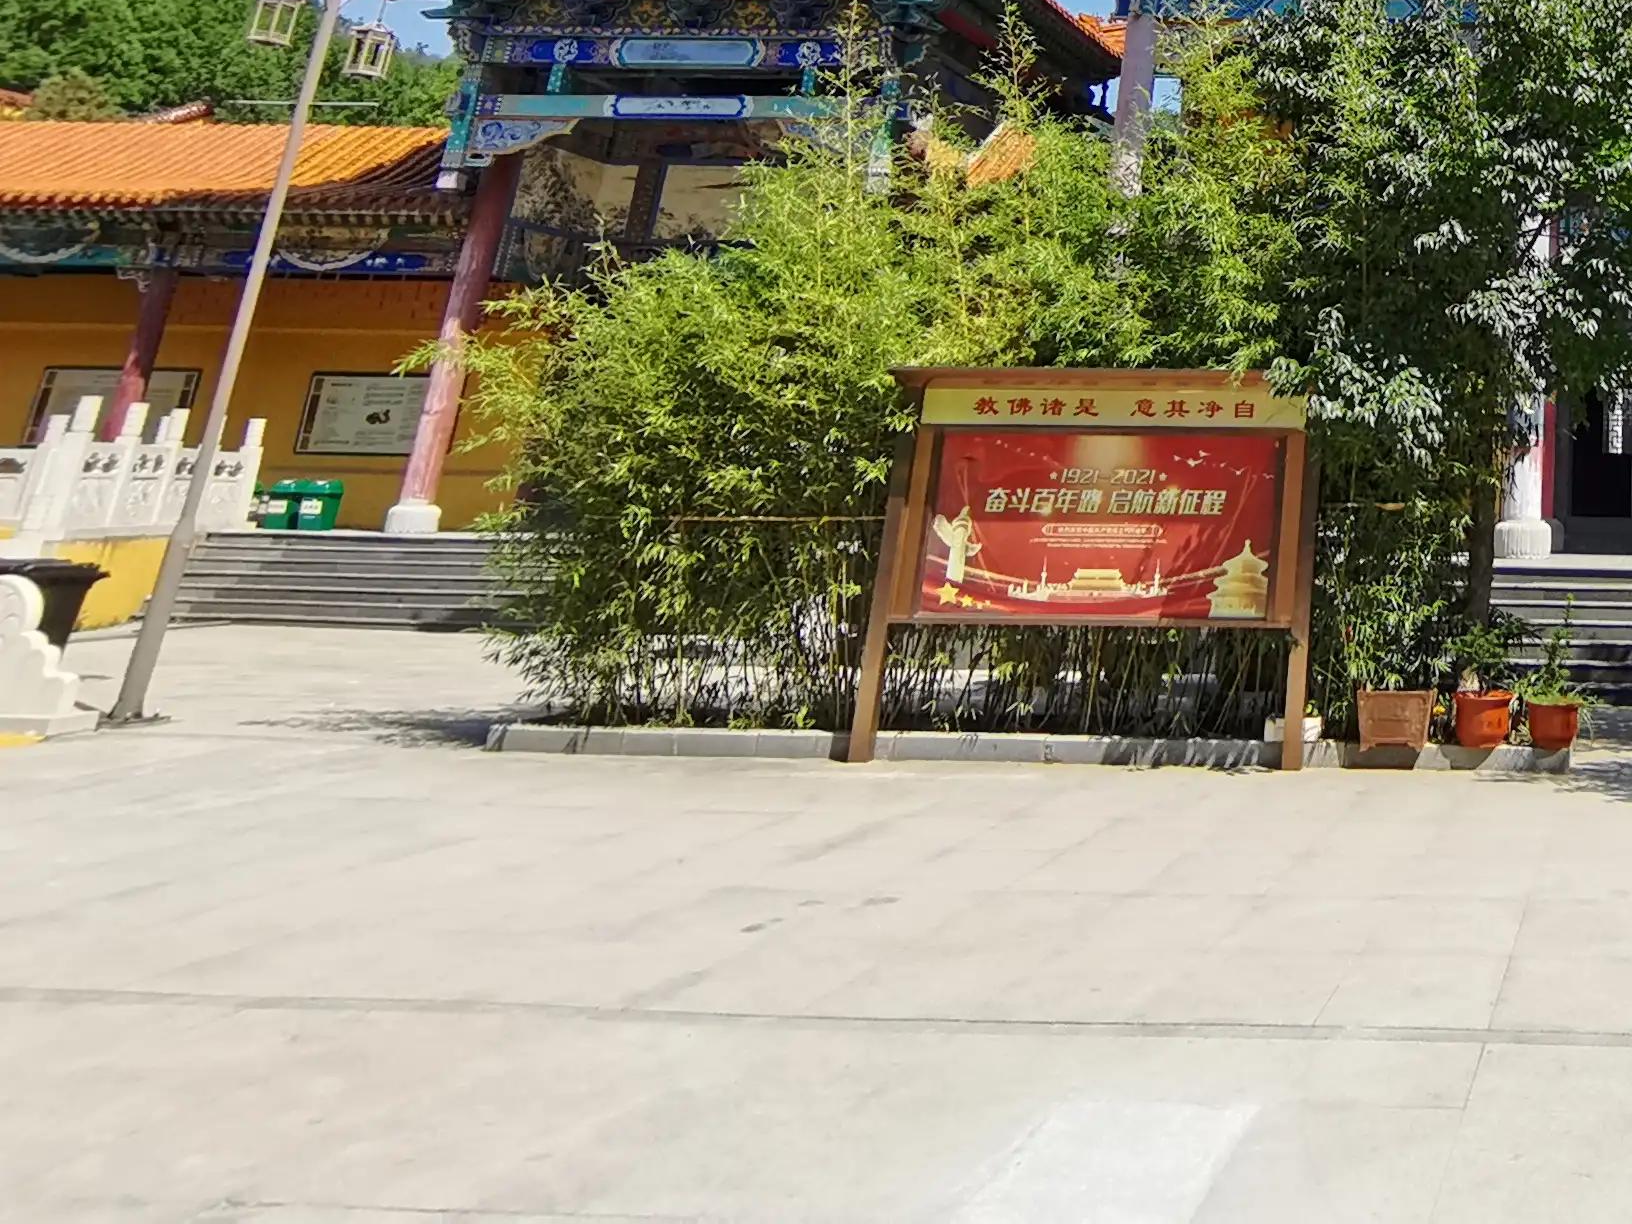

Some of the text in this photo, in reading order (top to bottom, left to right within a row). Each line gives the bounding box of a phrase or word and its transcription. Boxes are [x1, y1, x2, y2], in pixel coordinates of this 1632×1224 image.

[984, 486, 1227, 516] 奋斗百年路 启航新征程
